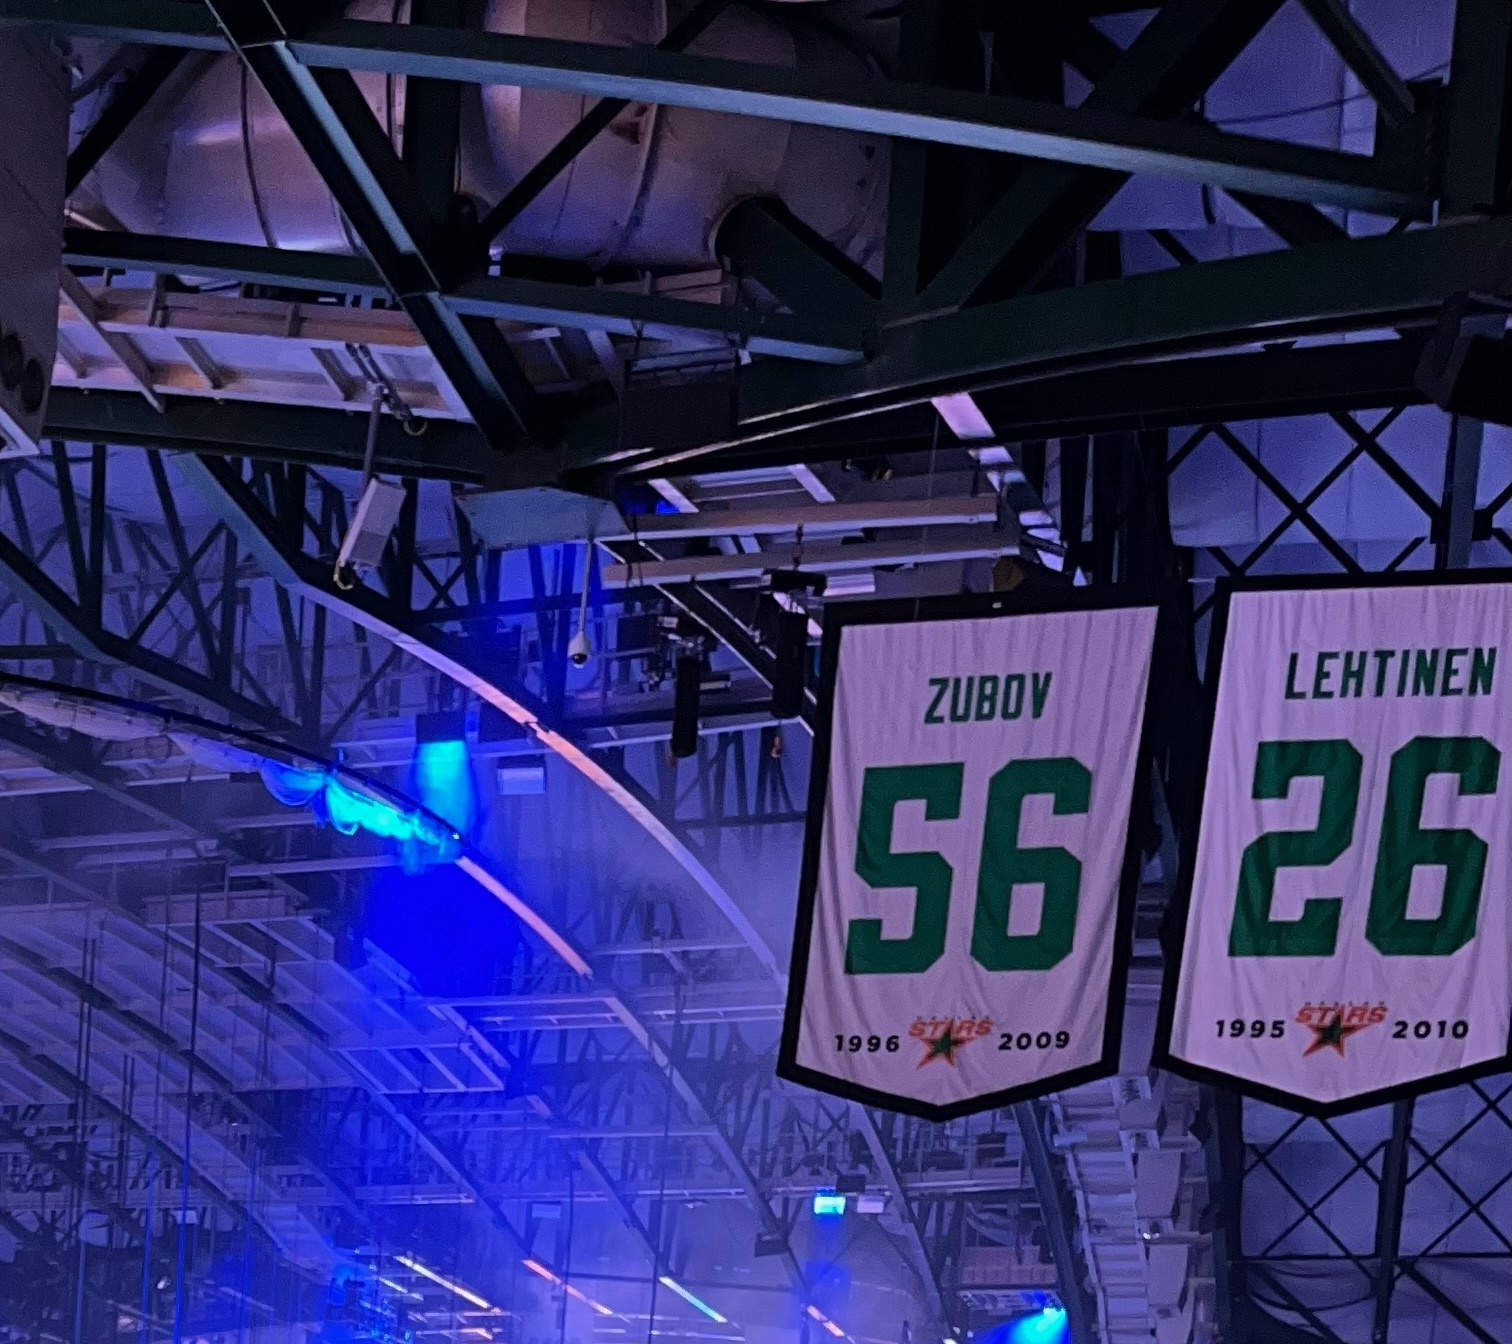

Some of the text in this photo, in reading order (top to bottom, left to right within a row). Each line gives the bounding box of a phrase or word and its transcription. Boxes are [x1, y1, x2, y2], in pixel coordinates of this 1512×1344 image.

[1284, 646, 1497, 701] LEHTINEN
[922, 671, 1053, 726] ZUBOV
[843, 756, 1093, 975] 56
[1227, 735, 1502, 958] 26
[834, 1031, 901, 1055] 1996
[997, 1029, 1071, 1052] 2009
[1215, 1018, 1285, 1040] 1995
[1392, 1019, 1469, 1041] 2010
